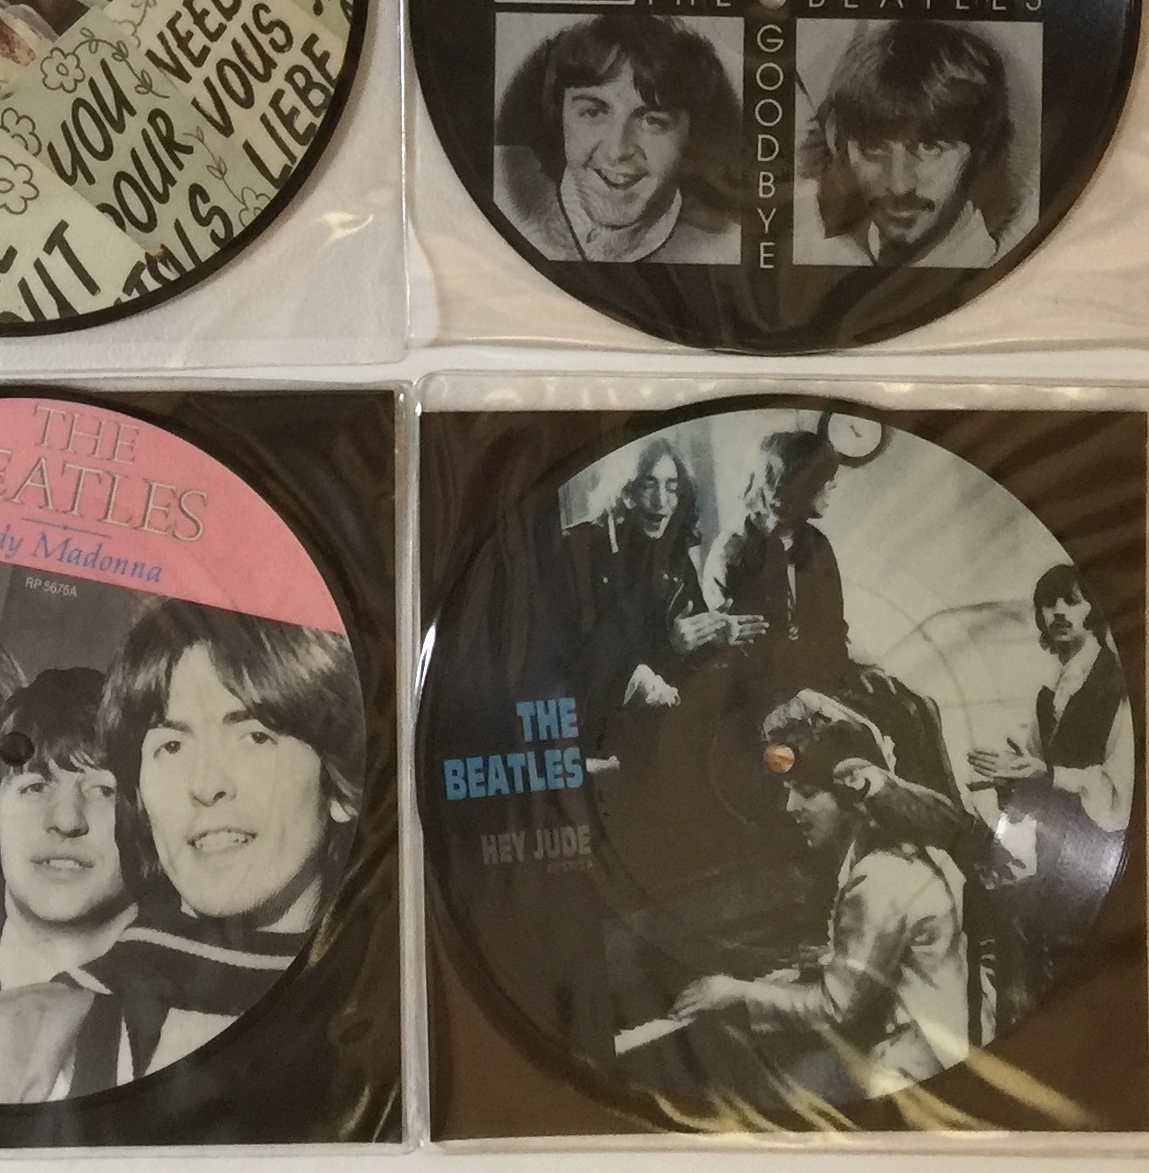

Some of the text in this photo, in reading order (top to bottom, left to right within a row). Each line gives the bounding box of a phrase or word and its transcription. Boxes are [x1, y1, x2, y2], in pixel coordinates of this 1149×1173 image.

[191, 3, 294, 138] VOUS
[47, 58, 137, 186] YOU
[754, 24, 784, 269] GOODBYE
[35, 403, 140, 465] THE
[25, 576, 42, 588] RP
[32, 532, 163, 583] Madonna
[516, 697, 579, 742] THE
[443, 747, 584, 800] BEATLES
[480, 825, 592, 865] HEY JUDE
